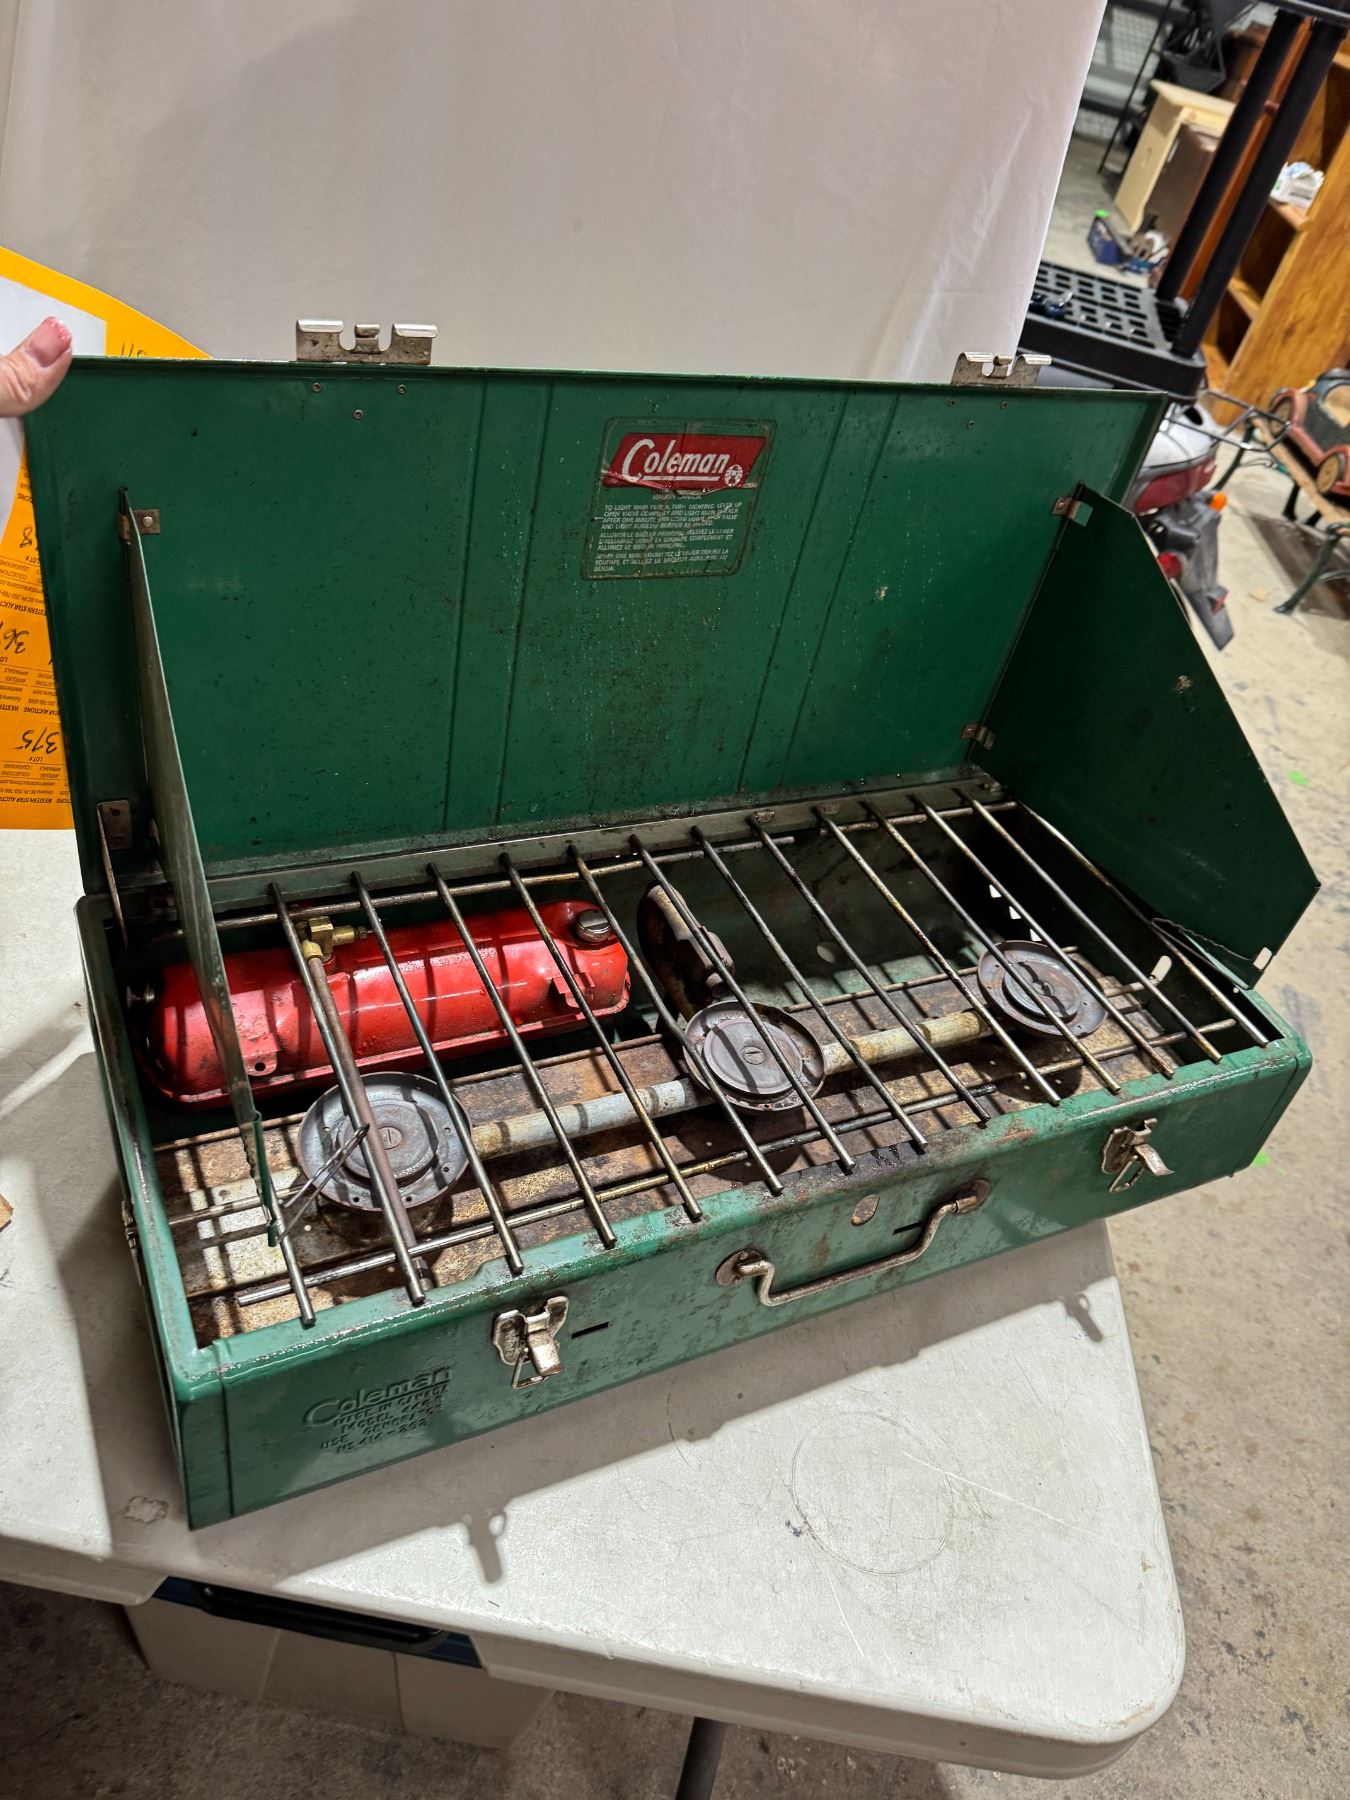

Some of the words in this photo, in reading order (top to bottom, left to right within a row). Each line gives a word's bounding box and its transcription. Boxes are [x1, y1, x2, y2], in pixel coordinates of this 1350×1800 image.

[621, 438, 731, 482] Coleman
[23, 706, 49, 714] AUCTIONS
[302, 1365, 451, 1428] Coleman
[333, 1407, 374, 1427] MADE
[378, 1401, 393, 1412] IN
[397, 1384, 448, 1406] CANADA
[341, 1412, 394, 1434] MODEL
[320, 1433, 349, 1449] USE
